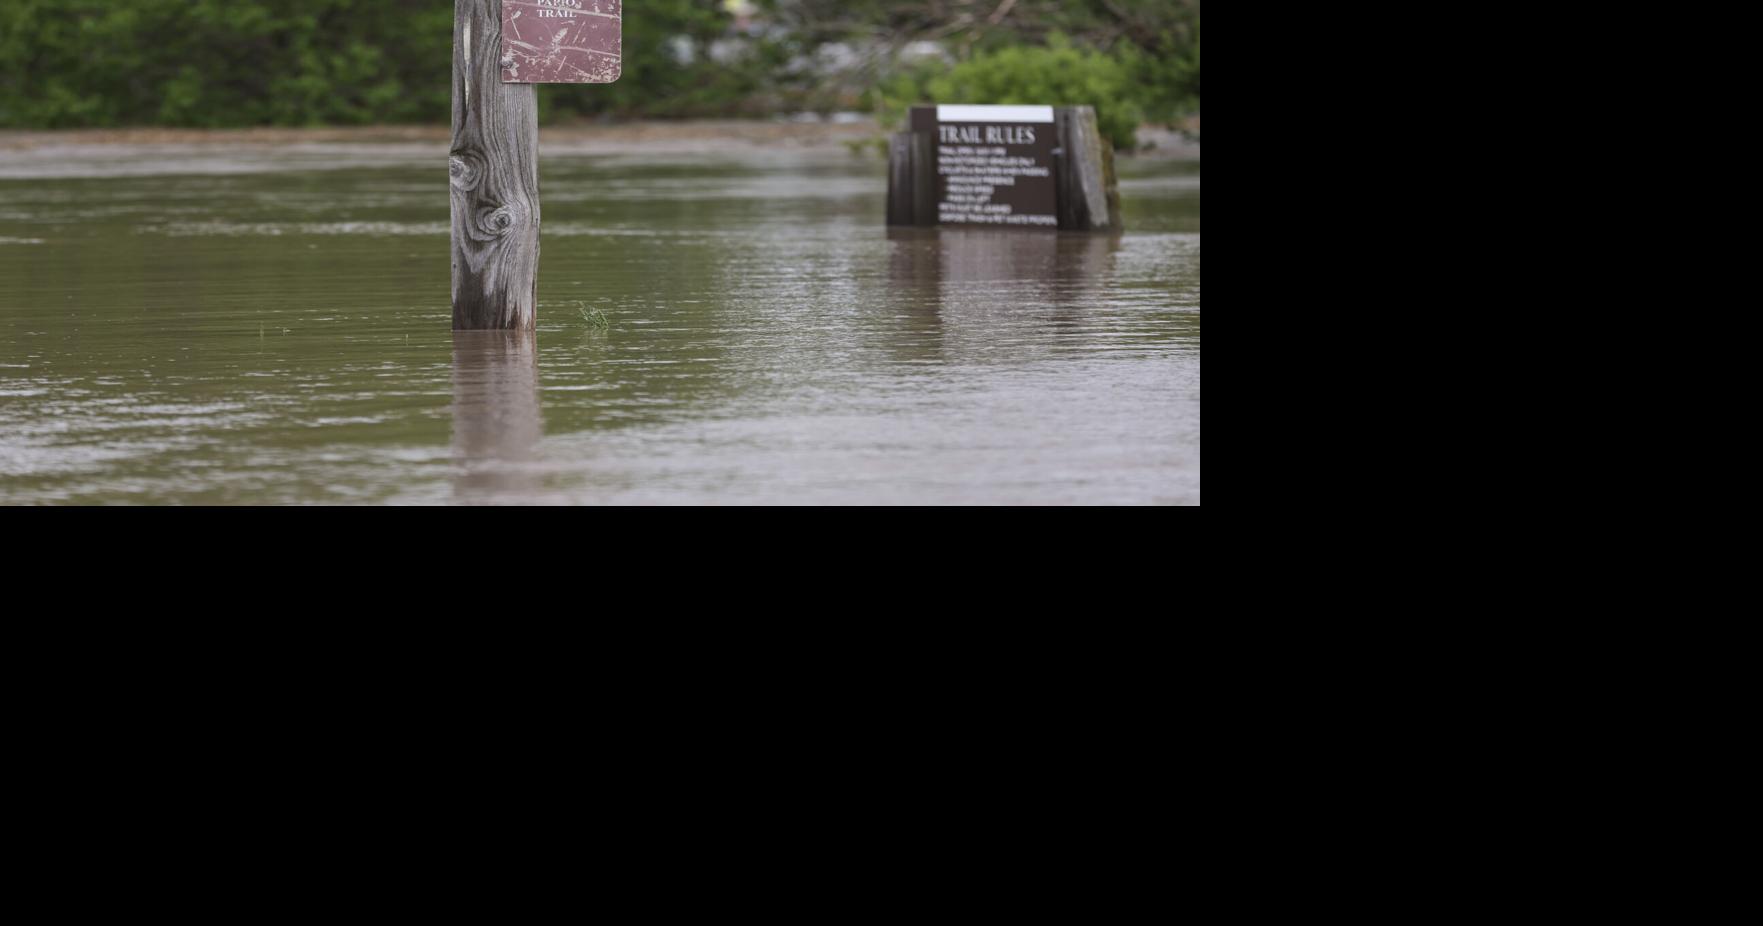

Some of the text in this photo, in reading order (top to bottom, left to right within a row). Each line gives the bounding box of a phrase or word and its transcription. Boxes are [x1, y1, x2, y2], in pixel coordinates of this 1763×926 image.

[536, 9, 577, 18] TRAIL
[939, 125, 1036, 144] TRAIL RULES
